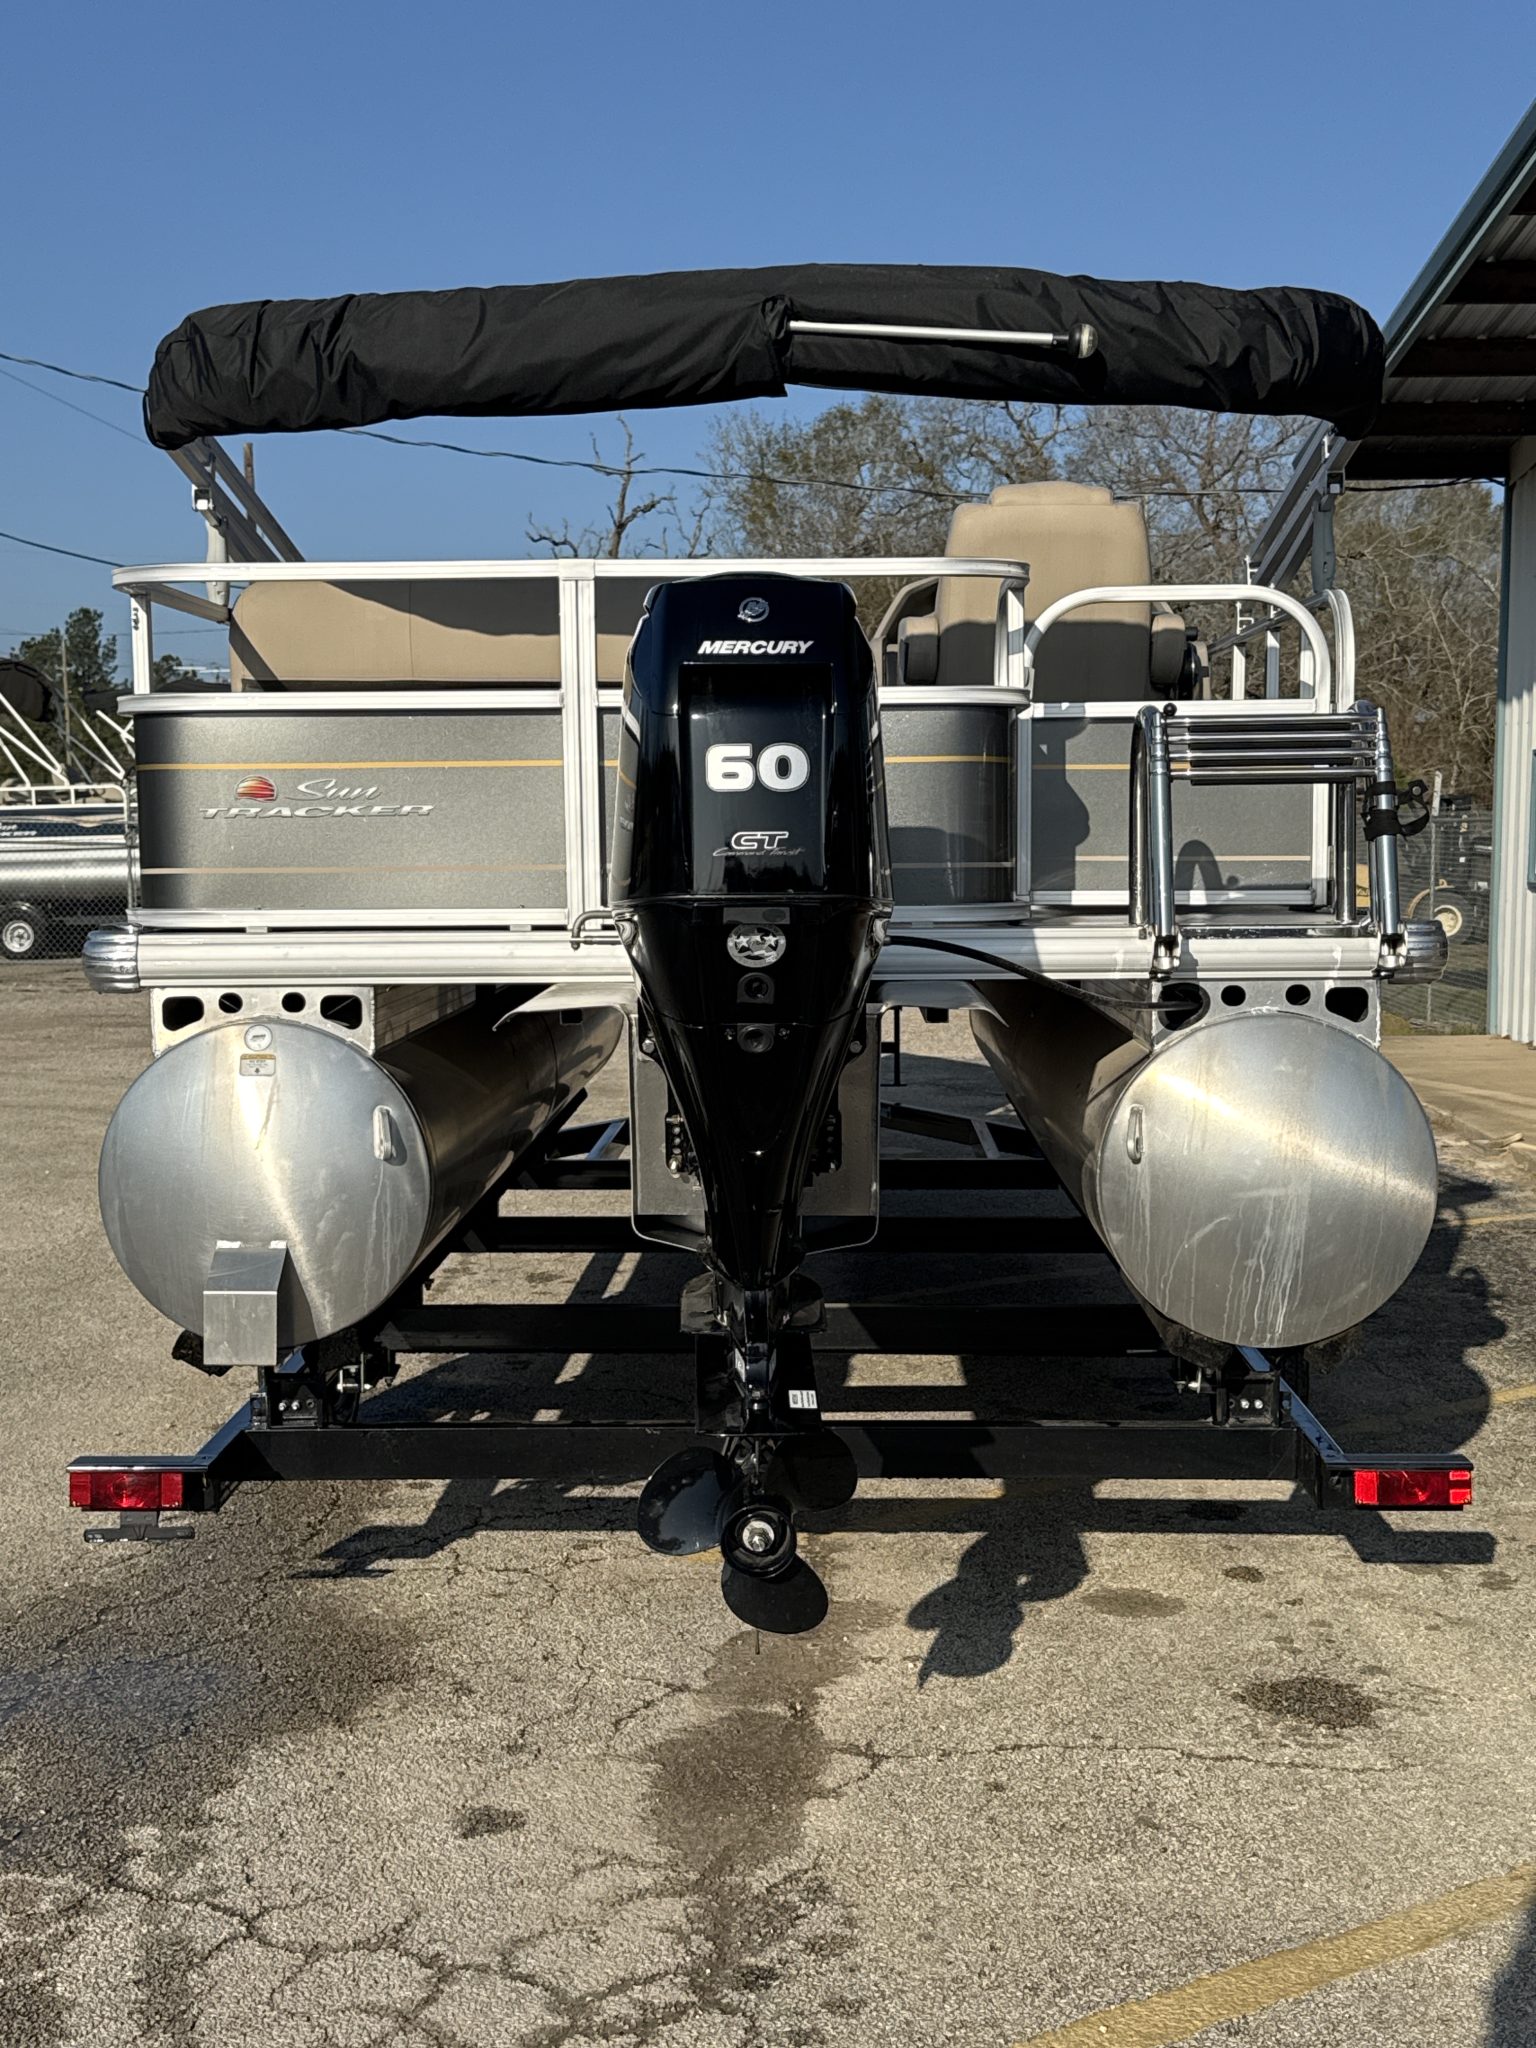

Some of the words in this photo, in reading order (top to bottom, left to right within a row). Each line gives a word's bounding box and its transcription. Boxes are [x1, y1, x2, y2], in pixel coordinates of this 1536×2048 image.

[697, 640, 814, 654] MERCURY
[705, 742, 811, 793] 60
[284, 778, 381, 801] Sun
[199, 805, 435, 820] TRACKER
[731, 831, 790, 850] GT
